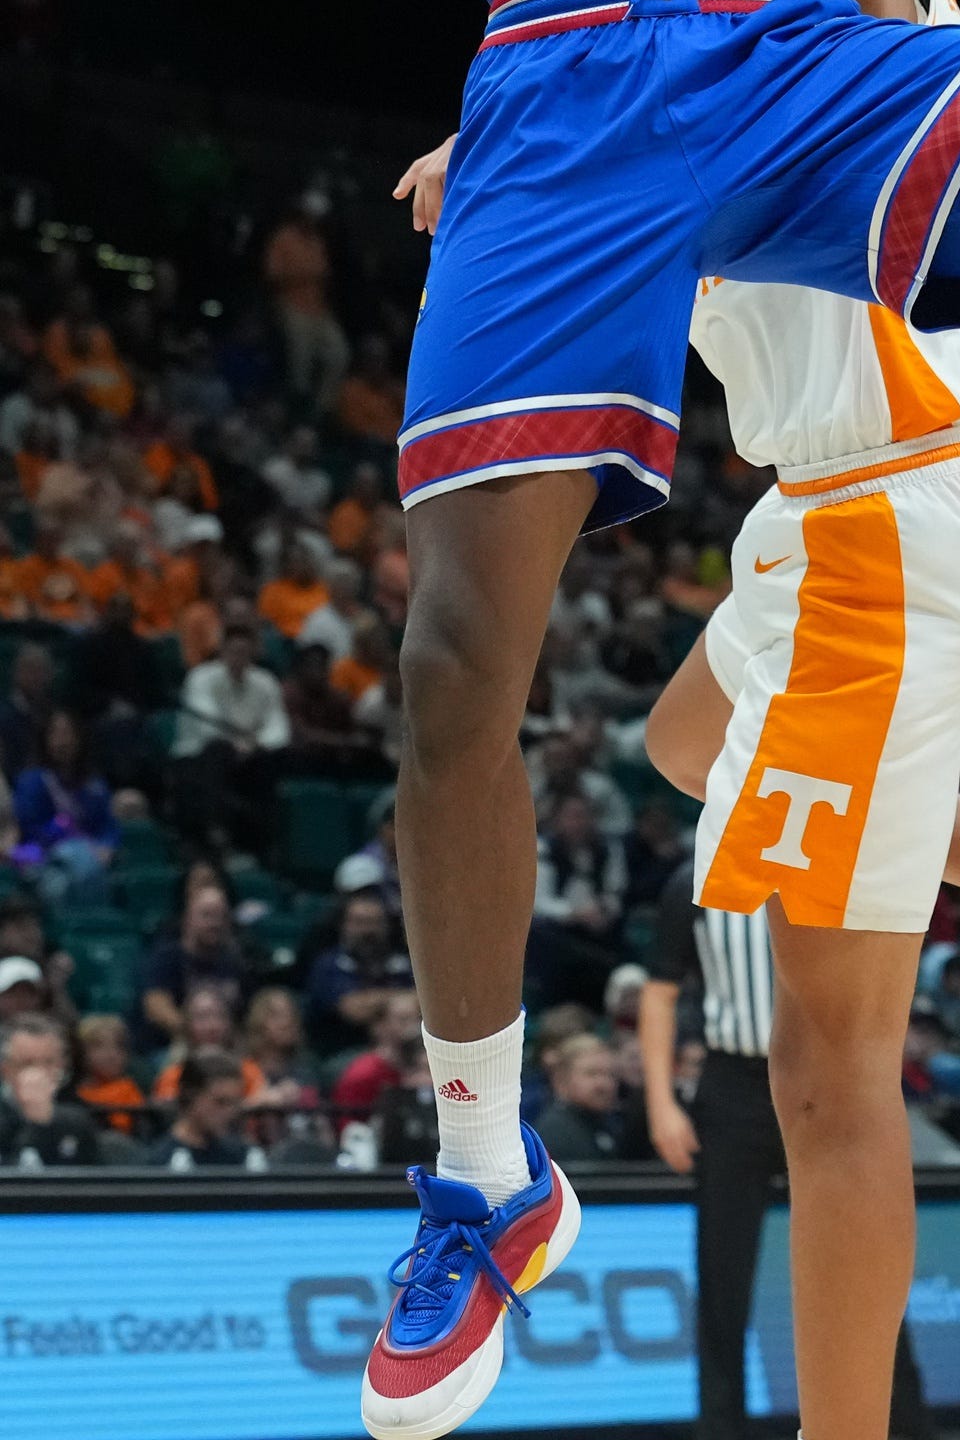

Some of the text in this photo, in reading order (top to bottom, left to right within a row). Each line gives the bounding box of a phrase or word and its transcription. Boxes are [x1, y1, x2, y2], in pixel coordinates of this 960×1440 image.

[756, 766, 853, 871] T
[438, 1087, 478, 1101] adidas
[110, 1312, 215, 1354] Good
[286, 1268, 693, 1376] GCO
